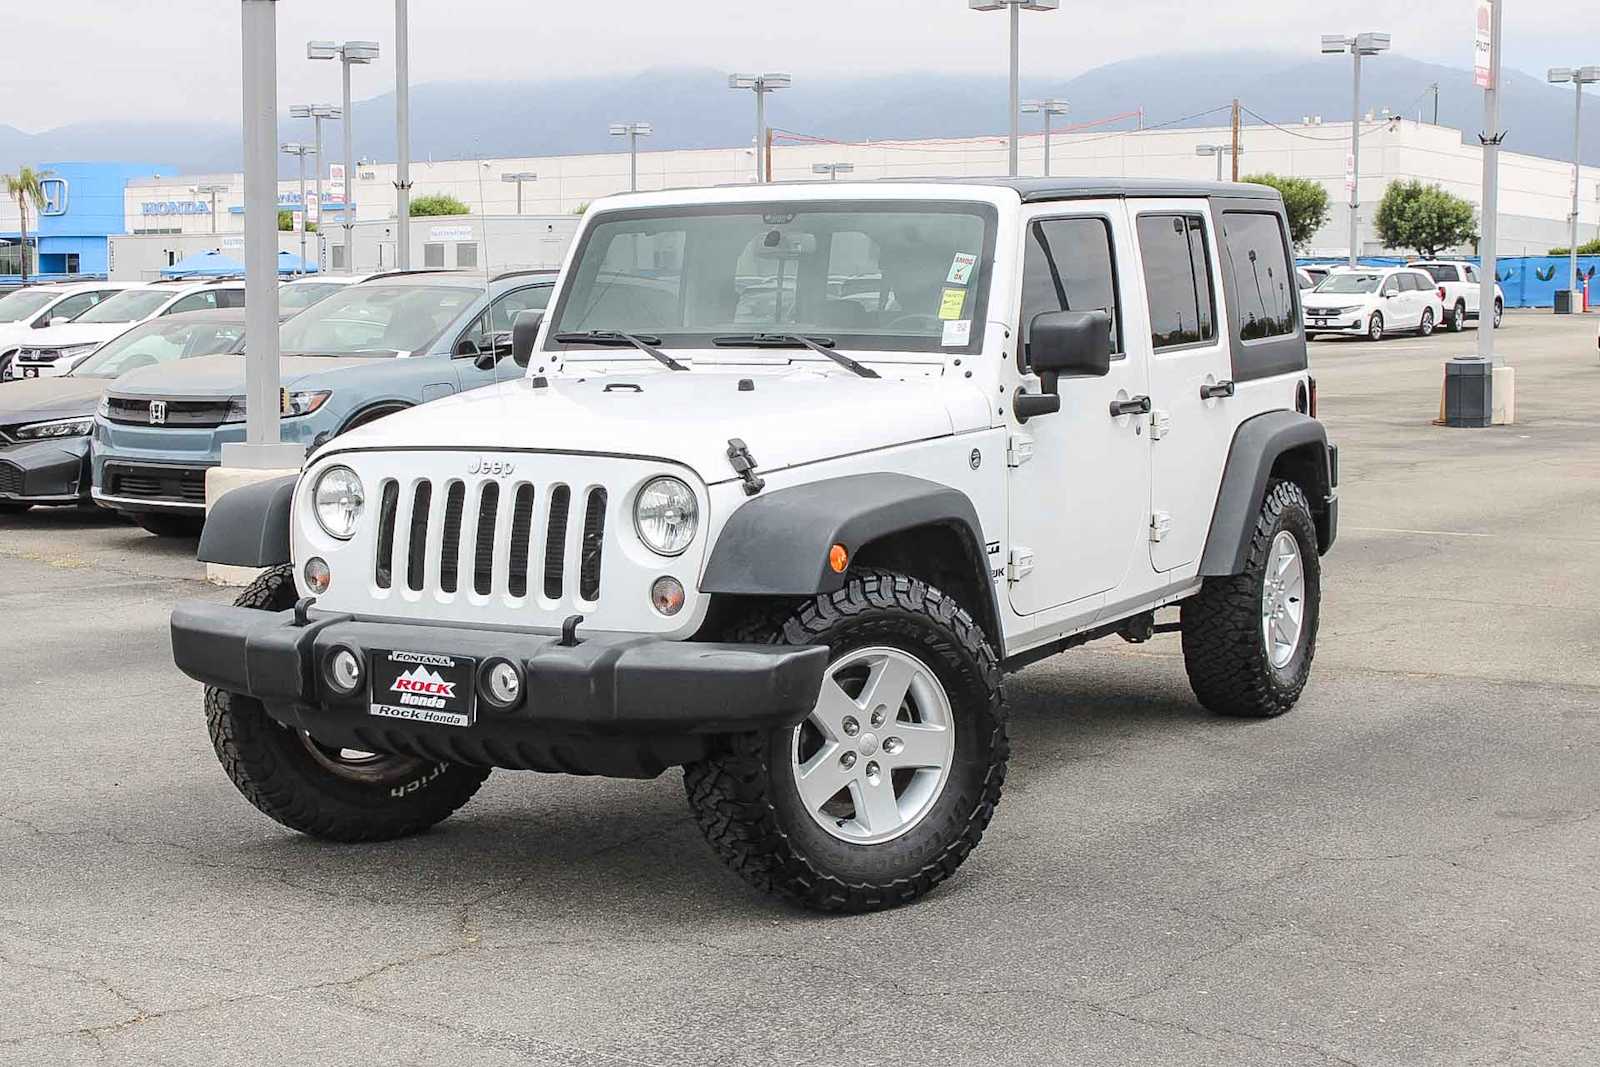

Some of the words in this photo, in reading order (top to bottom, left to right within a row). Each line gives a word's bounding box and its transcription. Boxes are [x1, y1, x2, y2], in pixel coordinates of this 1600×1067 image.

[142, 201, 211, 216] HONDA
[468, 455, 515, 478] Jeep
[395, 653, 449, 665] FONTANA
[396, 679, 450, 695] ROCK
[400, 693, 446, 709] Honda
[379, 705, 420, 719] Rock
[424, 711, 461, 725] Honda
